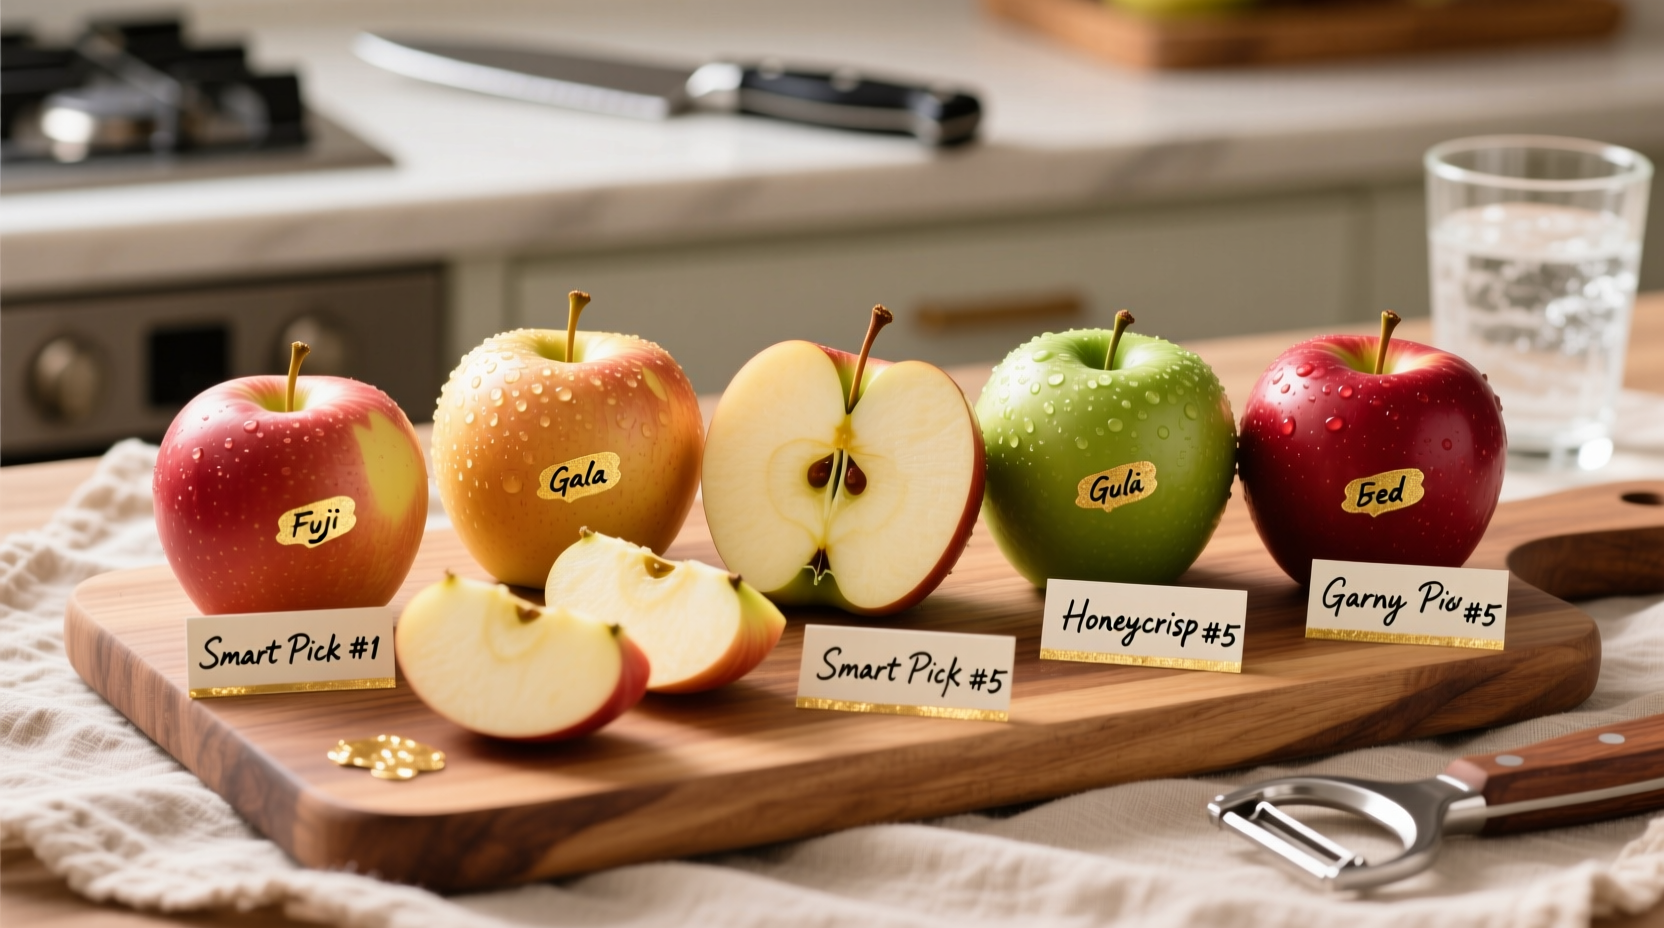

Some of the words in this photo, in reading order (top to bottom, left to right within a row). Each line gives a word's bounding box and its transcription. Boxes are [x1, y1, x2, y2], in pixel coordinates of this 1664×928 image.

[549, 460, 609, 498] Gala
[292, 508, 340, 545] Fuji
[1062, 598, 1199, 648] Honeycrisp
[1201, 621, 1241, 648] #5
[1322, 576, 1408, 627] Garny
[1463, 602, 1503, 627] #5
[198, 635, 282, 670] Smart
[287, 632, 341, 665] Pick
[348, 635, 381, 660] #1
[816, 646, 902, 682] Smart
[907, 651, 962, 698] Pick
[969, 667, 1008, 694] #5
